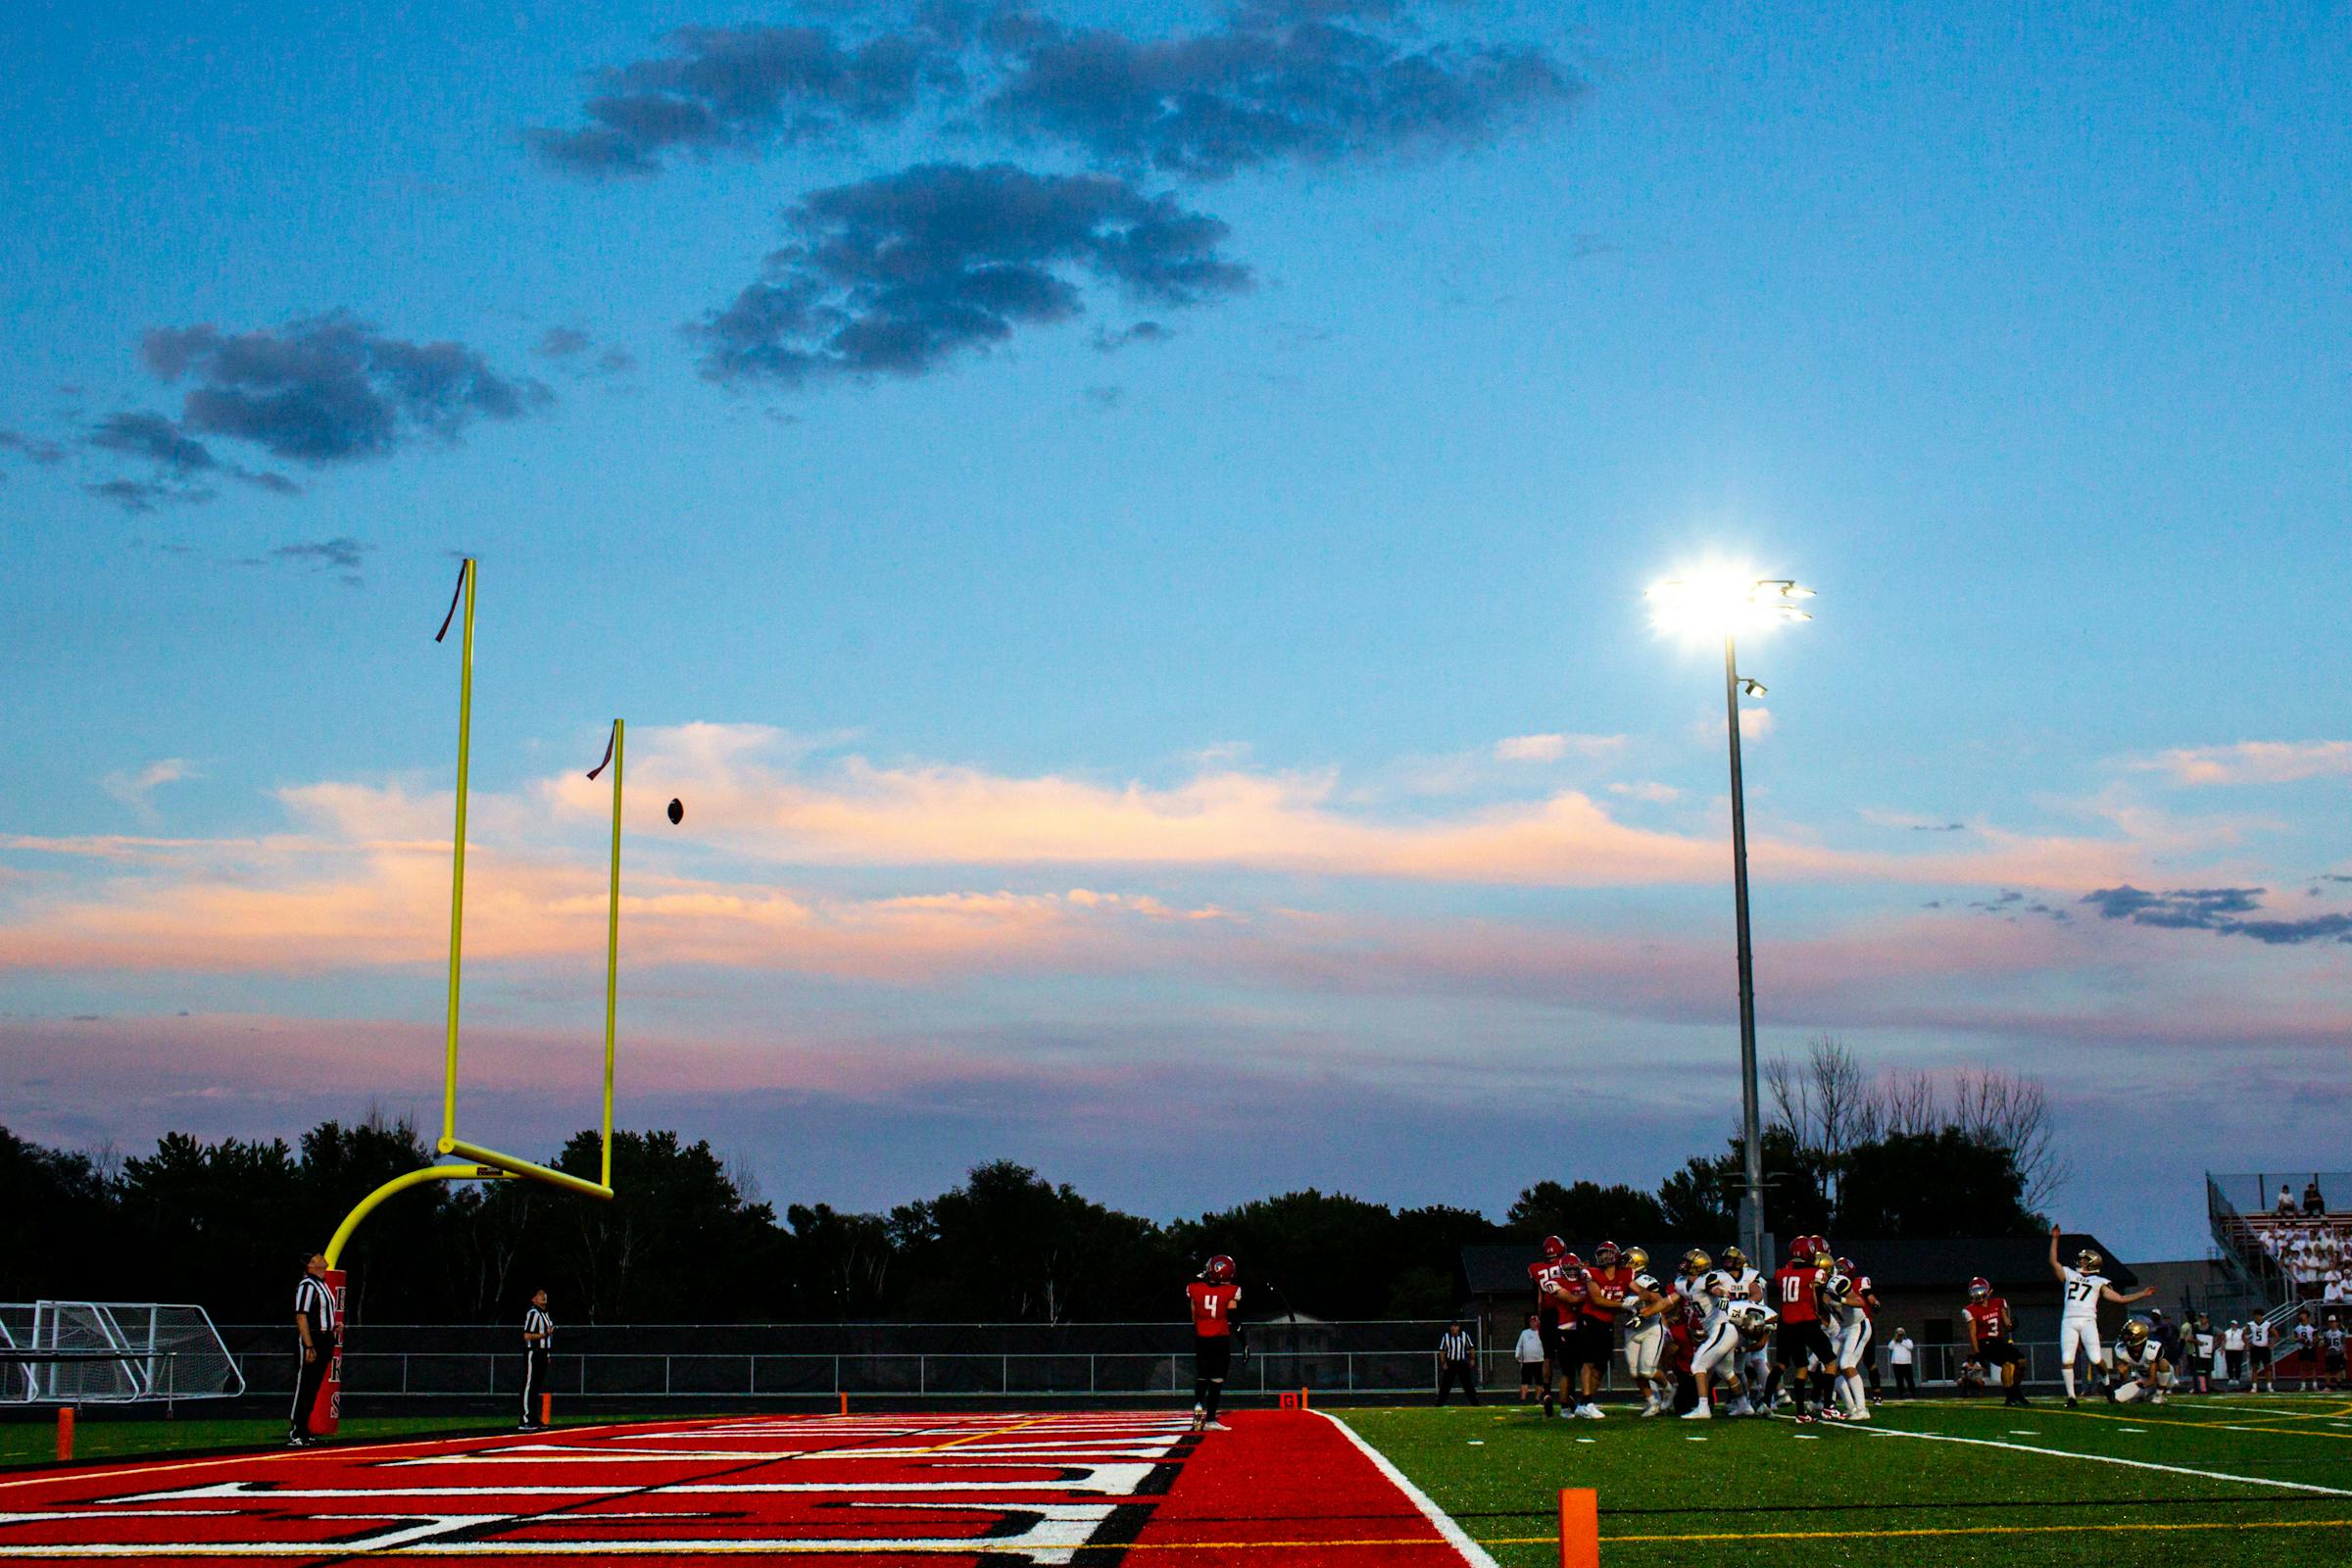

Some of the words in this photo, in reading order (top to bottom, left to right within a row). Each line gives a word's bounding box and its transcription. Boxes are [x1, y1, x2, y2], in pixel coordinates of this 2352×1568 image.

[1782, 1276, 1801, 1302] 10
[2068, 1281, 2092, 1301] 27
[1204, 1295, 1217, 1318] 4
[1987, 1317, 1999, 1337] 3
[2256, 1331, 2263, 1342] 5
[1284, 1395, 1295, 1408] G
